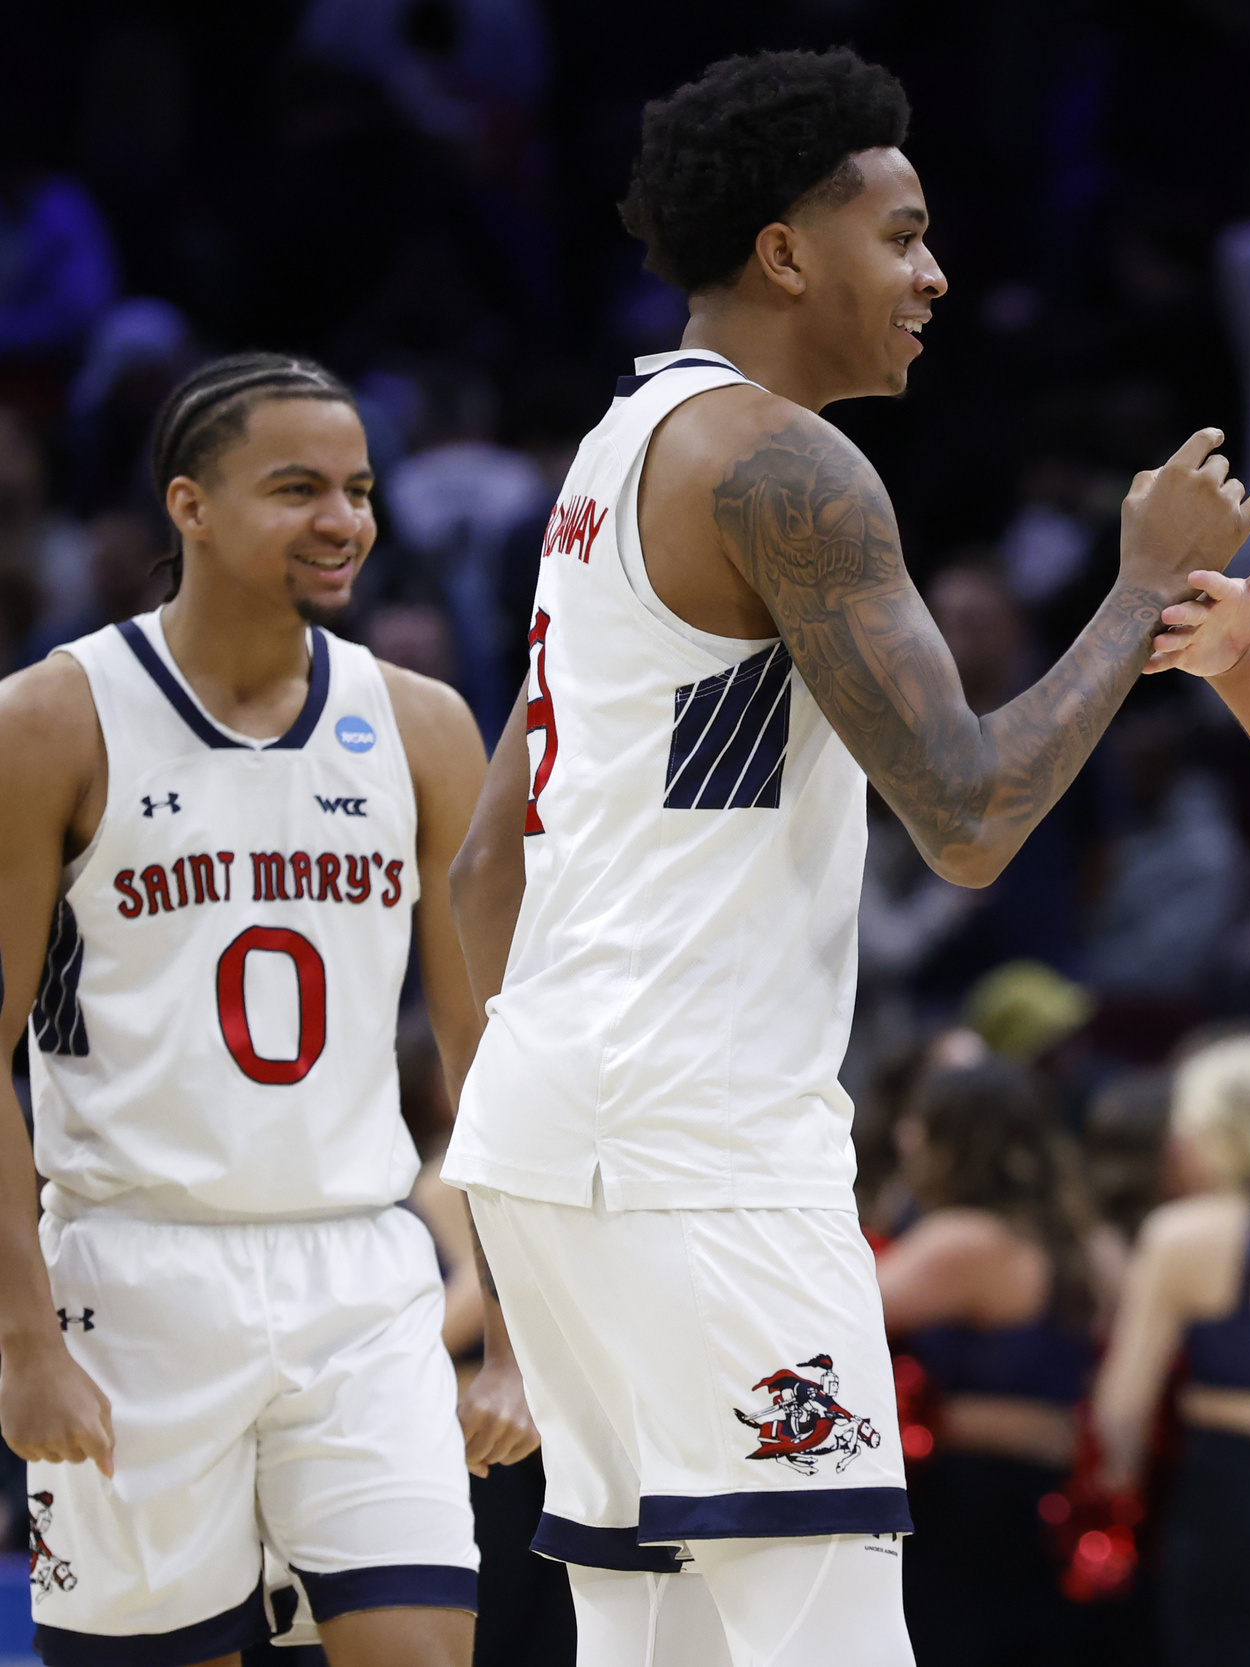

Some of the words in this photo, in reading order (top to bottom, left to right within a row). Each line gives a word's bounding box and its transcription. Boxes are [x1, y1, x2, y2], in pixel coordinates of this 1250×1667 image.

[341, 731, 374, 744] NCAA
[314, 795, 368, 816] WCC
[114, 851, 235, 918] SAINT
[250, 851, 404, 907] MARY'S
[216, 925, 326, 1086] 0
